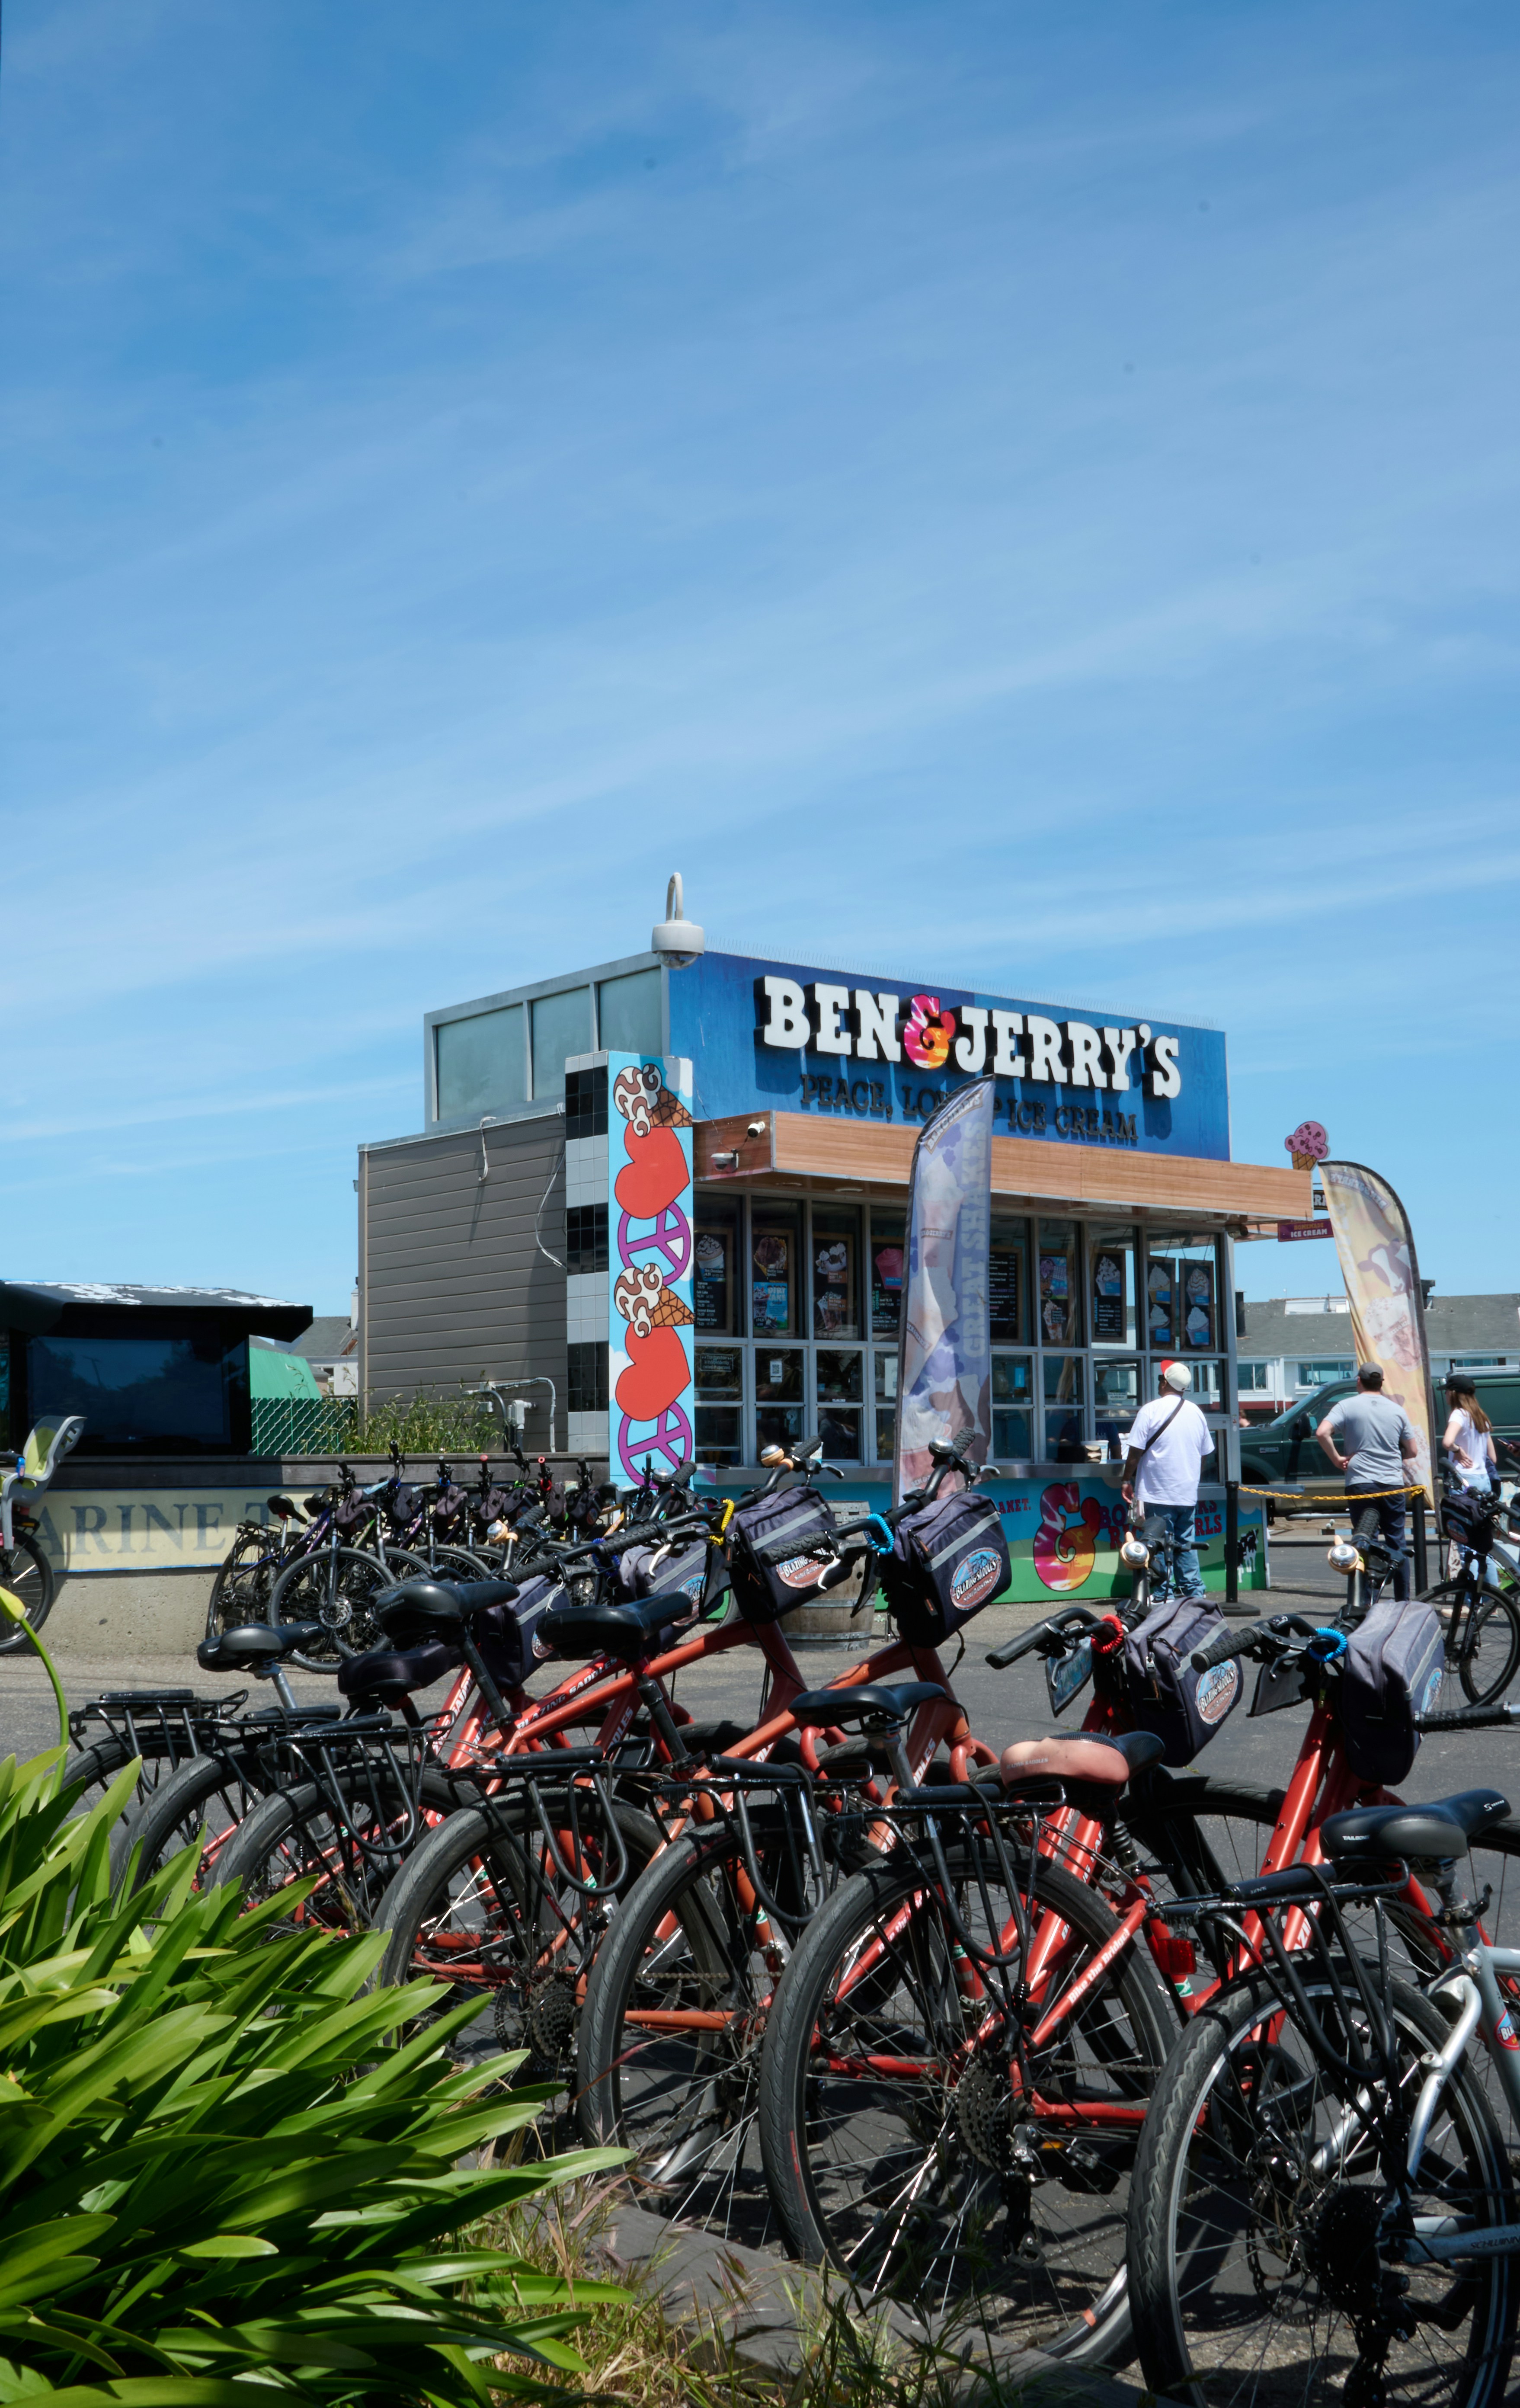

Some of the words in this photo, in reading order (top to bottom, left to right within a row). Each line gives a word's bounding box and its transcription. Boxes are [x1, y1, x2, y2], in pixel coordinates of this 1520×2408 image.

[761, 975, 901, 1062] BEN
[904, 993, 956, 1070] &
[954, 1005, 1181, 1100] JERRY'S
[800, 1073, 893, 1118] PEACE,
[1008, 1099, 1046, 1129] ICE
[1056, 1105, 1139, 1140] CREAM
[961, 1121, 987, 1250] SHAKES
[1293, 1222, 1324, 1230] HOMEMADE
[1303, 1228, 1328, 1237] CREAM
[35, 1502, 226, 1557] ARINE
[516, 1694, 566, 1730] BLAZING
[569, 1656, 618, 1695] SADDLES
[1068, 1979, 1088, 2004] Bike
[1087, 1962, 1103, 1982] the
